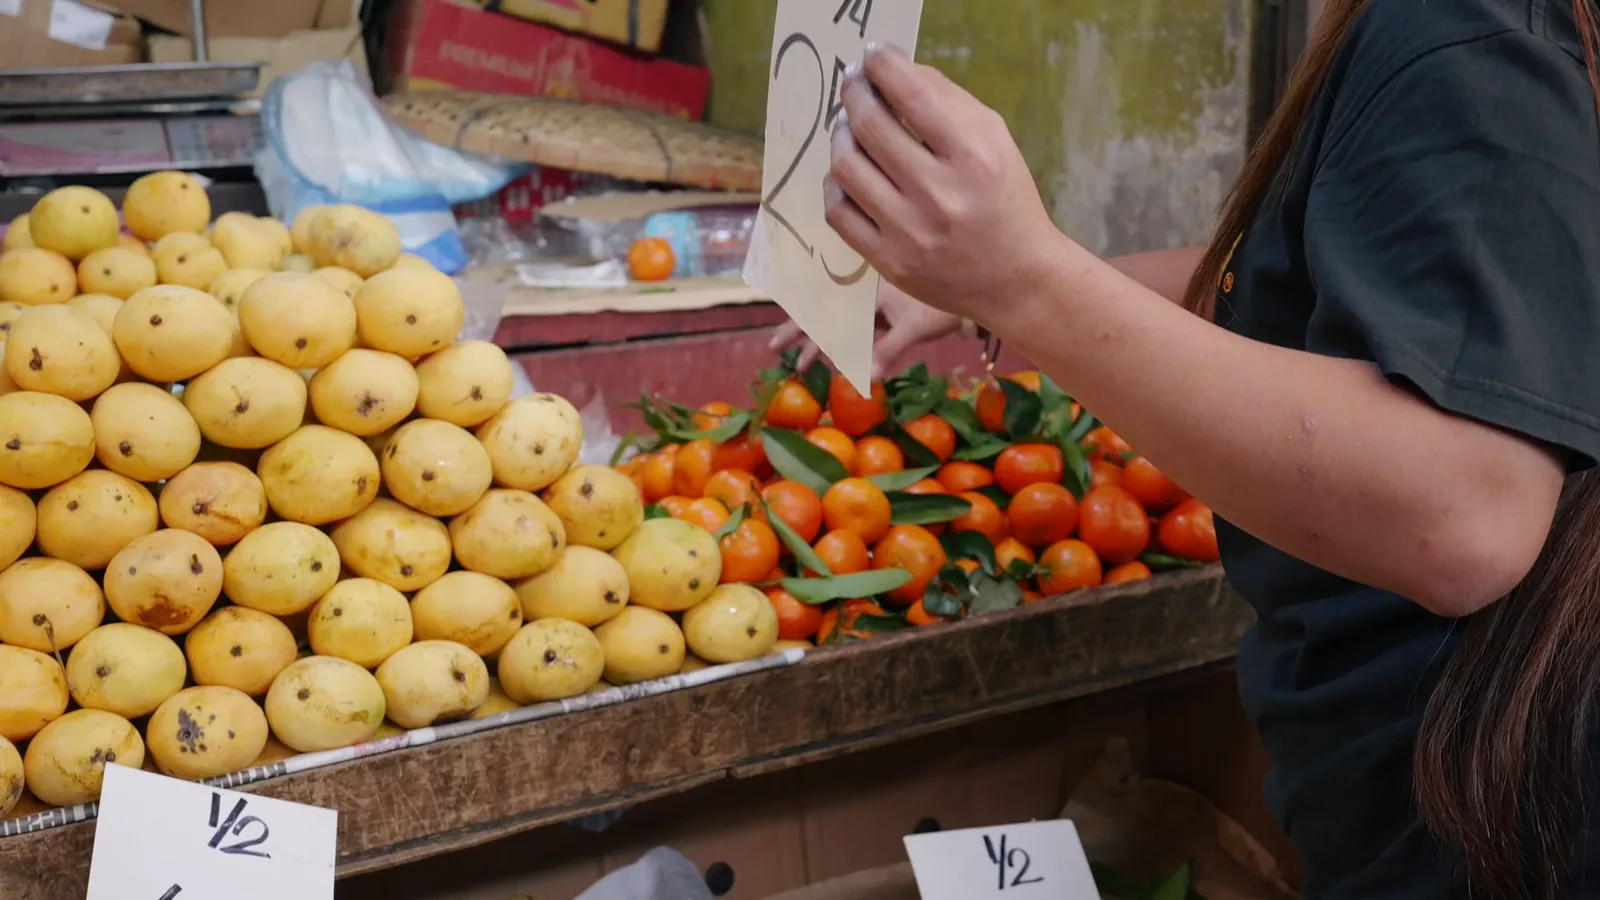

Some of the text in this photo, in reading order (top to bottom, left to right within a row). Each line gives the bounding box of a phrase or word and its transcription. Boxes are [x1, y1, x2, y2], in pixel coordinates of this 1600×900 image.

[438, 39, 535, 80] PREMIUM
[207, 792, 272, 859] 1/2
[982, 834, 1045, 890] 1/2
